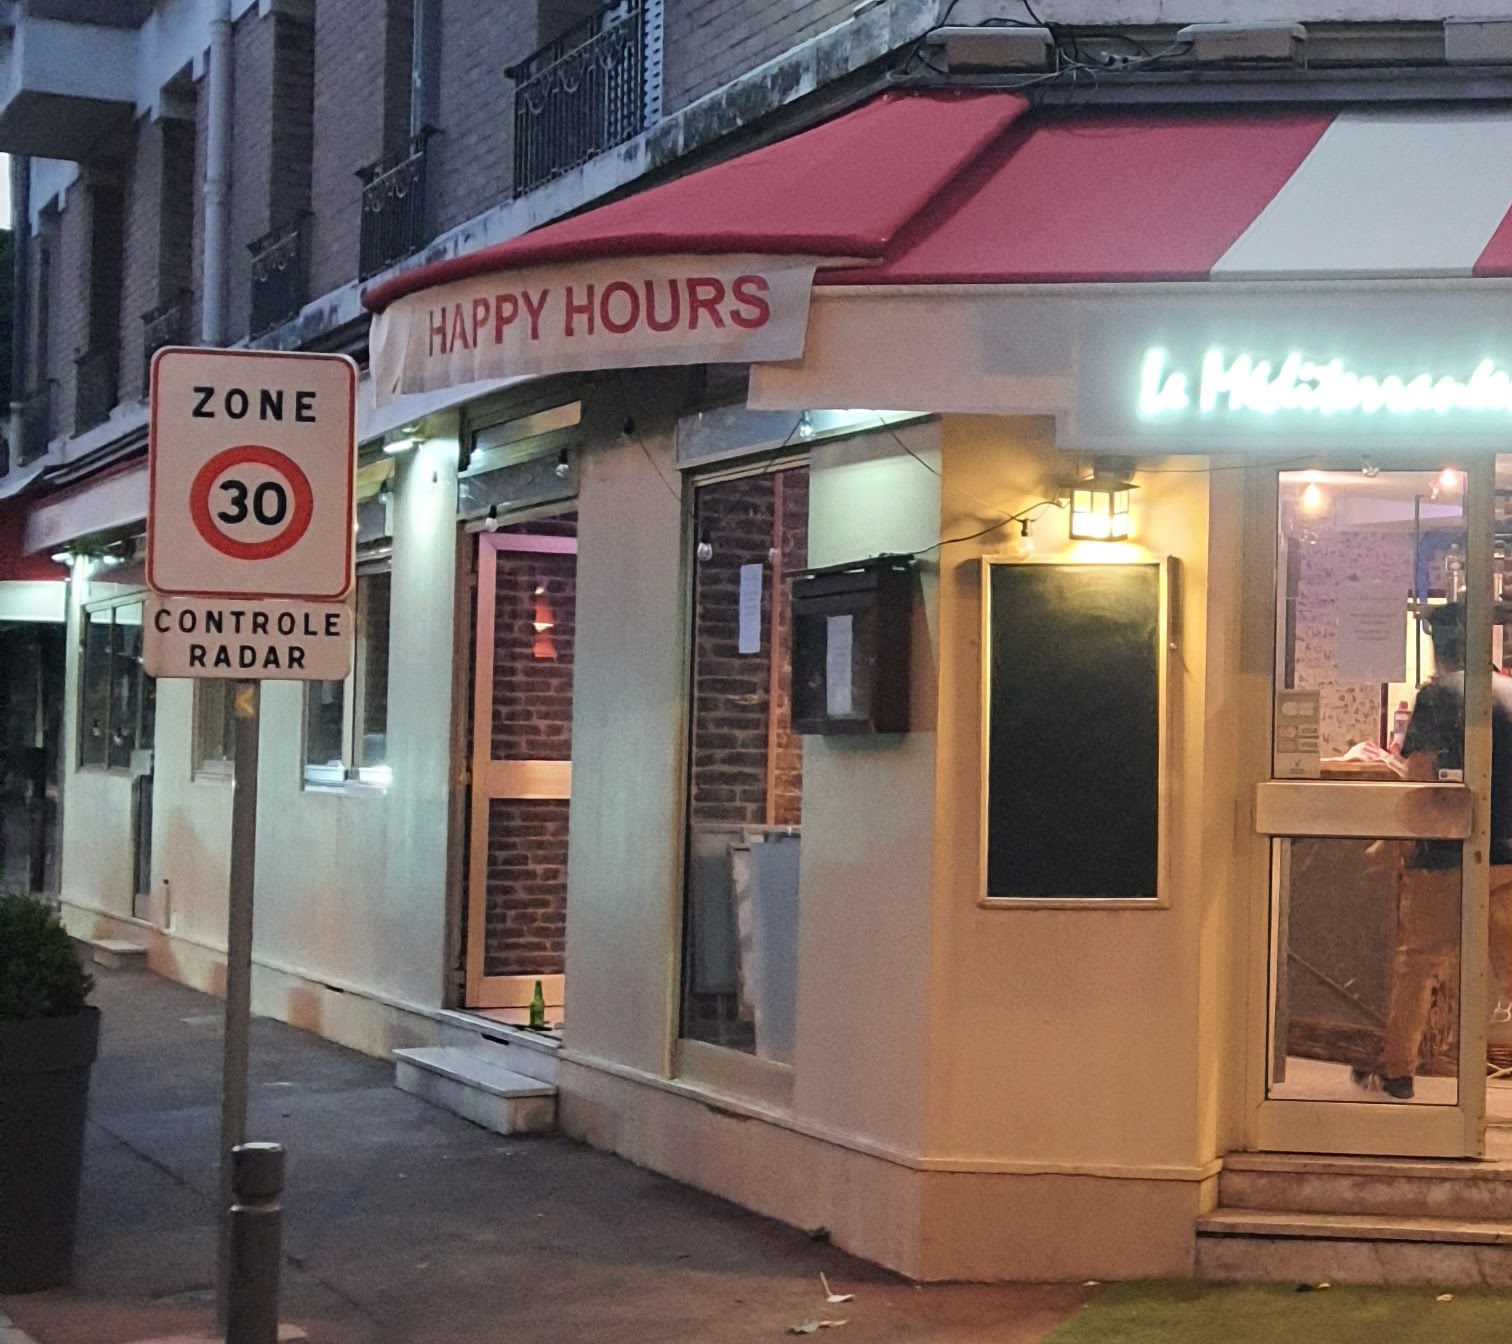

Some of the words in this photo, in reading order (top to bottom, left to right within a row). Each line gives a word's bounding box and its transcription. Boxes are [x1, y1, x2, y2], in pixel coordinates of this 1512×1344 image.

[429, 288, 550, 357] HAPPY
[564, 274, 771, 338] HOURS
[191, 385, 317, 423] ZONE
[216, 479, 288, 526] 30
[154, 608, 341, 637] CONTROLE
[188, 643, 306, 670] RADAR
